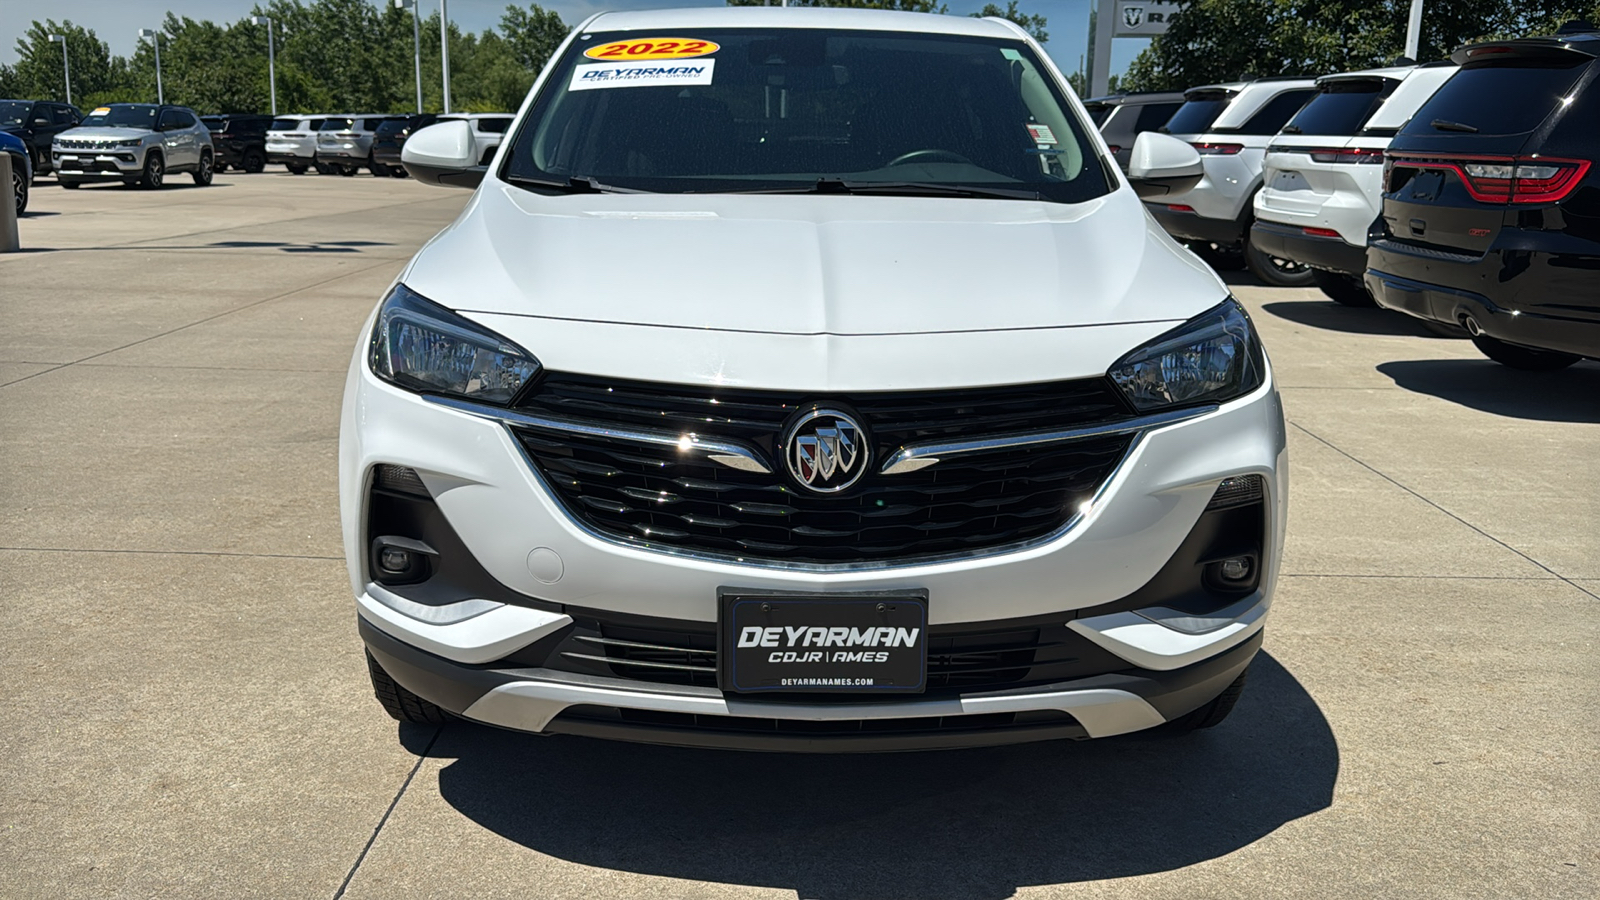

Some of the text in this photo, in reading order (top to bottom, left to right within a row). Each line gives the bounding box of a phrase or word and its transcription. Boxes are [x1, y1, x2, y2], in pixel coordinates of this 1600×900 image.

[598, 42, 707, 57] 2022
[582, 67, 705, 79] DEYARMAN
[737, 626, 919, 648] DEYARMAN
[768, 652, 889, 663] CDJR AMES
[781, 678, 874, 686] DEYARMANAMES.COM
